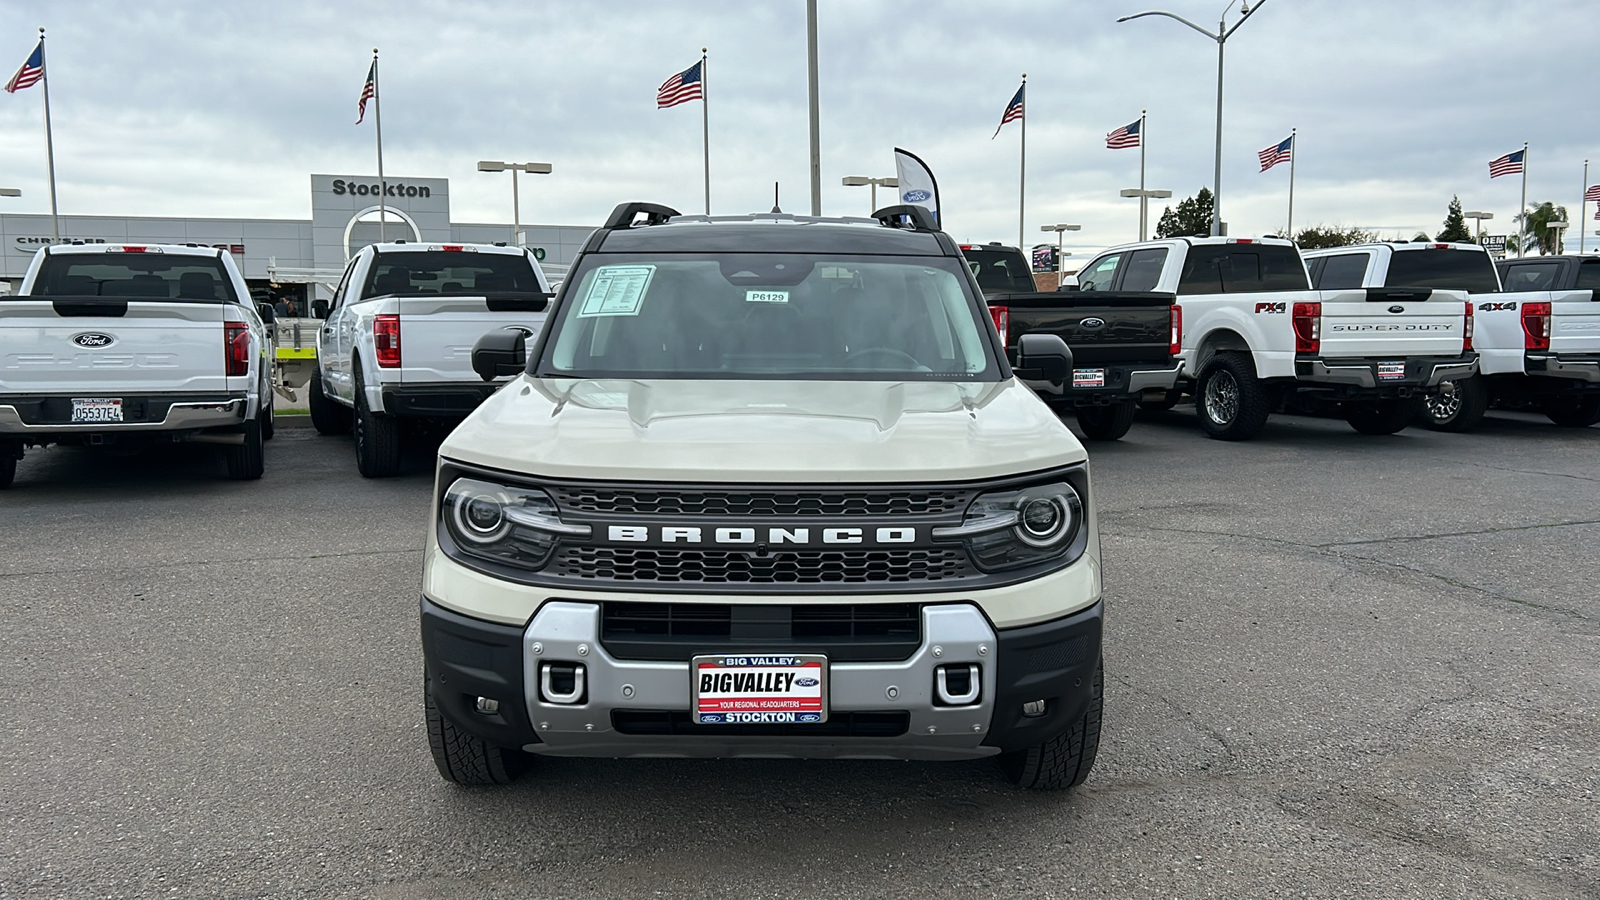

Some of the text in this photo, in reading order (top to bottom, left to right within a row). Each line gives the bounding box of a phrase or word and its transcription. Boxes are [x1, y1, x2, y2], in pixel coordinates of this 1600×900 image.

[332, 179, 431, 198] Stockton
[1482, 236, 1505, 245] OEM
[752, 293, 784, 301] P6129
[1254, 302, 1287, 314] FX4
[80, 335, 106, 345] Ford
[608, 525, 916, 544] BRONCO
[726, 657, 794, 666] BIG VALLEY
[699, 672, 796, 693] BIGVALLEY
[798, 678, 816, 686] Ford
[719, 700, 800, 709] YOUR REGIONAL HEADQUARTERS
[725, 712, 796, 723] STOCKTON
